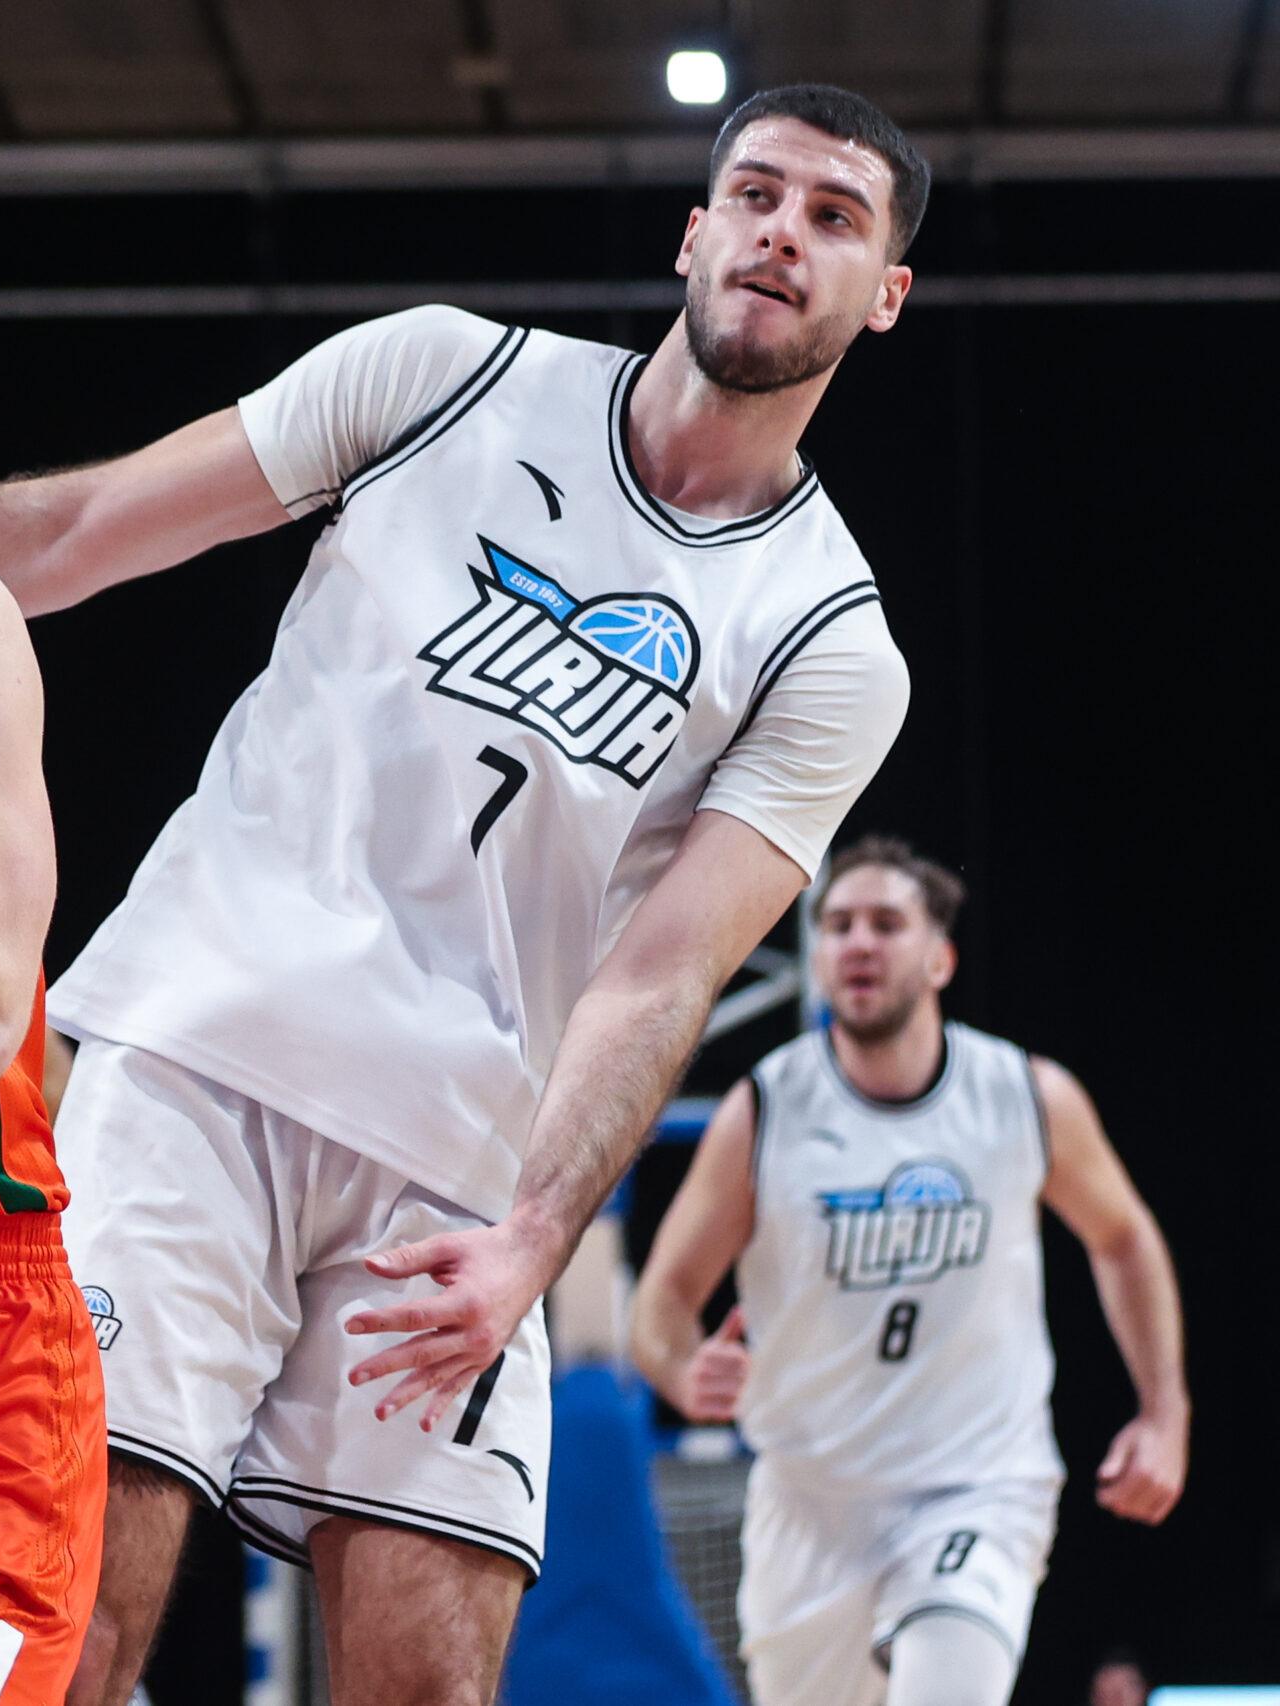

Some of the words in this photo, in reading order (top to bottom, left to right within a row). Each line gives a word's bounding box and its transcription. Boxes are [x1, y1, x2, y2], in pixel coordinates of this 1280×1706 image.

[470, 744, 529, 860] 7
[877, 1299, 919, 1363] 8
[935, 1529, 978, 1576] 8
